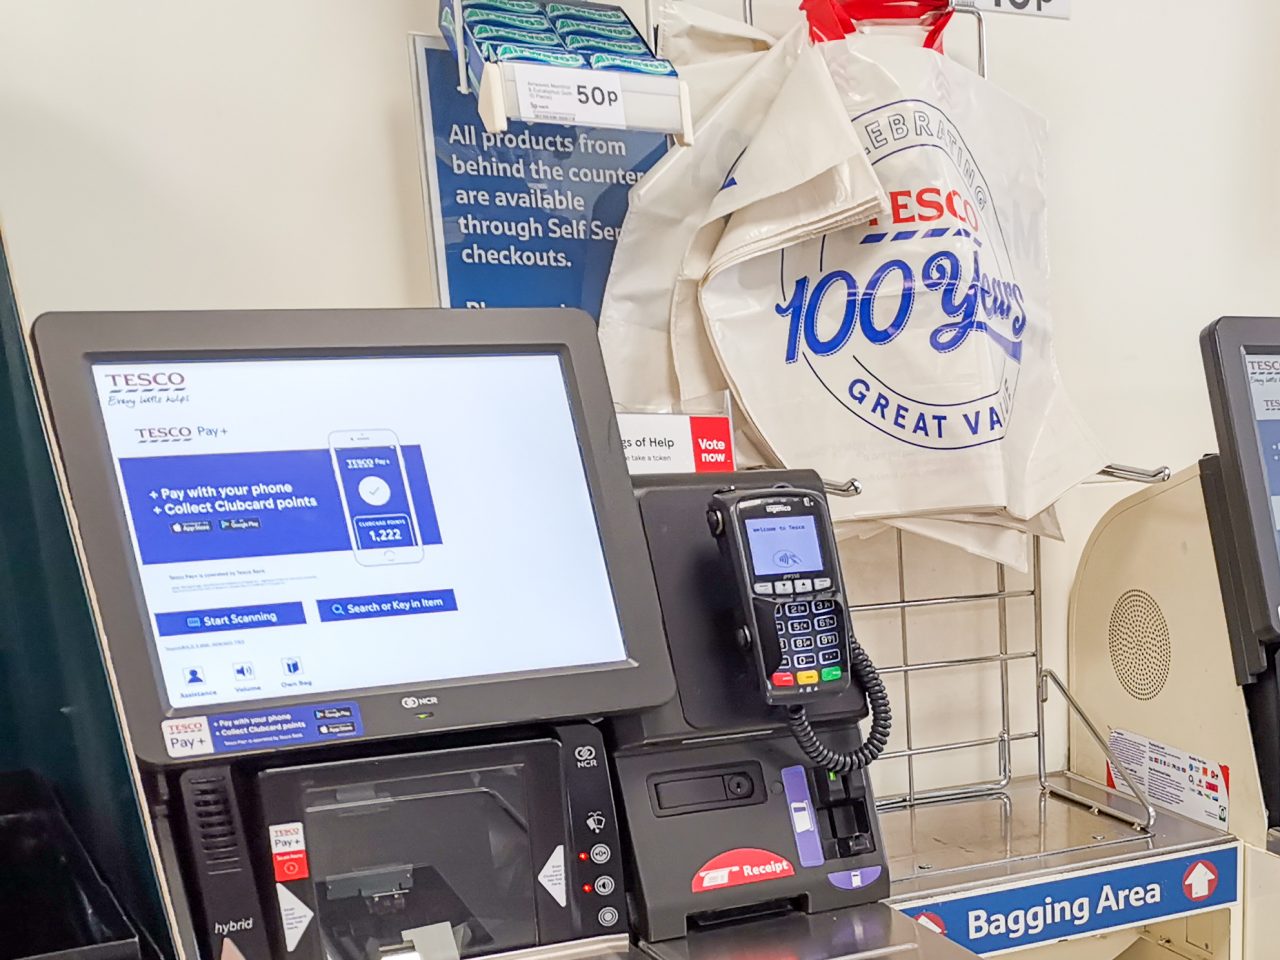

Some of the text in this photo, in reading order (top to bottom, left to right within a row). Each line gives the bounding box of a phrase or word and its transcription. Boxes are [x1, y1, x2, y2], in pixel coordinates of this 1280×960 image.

[576, 84, 618, 107] 50p
[449, 123, 626, 156] All products from
[452, 155, 643, 185] behind the counter
[864, 110, 988, 212] EBRATING
[456, 188, 585, 211] are available
[458, 215, 543, 241] through
[547, 218, 587, 240] Self
[461, 244, 572, 268] checkouts.
[775, 251, 1028, 364] 100 Years
[104, 372, 185, 387] TESCO
[848, 378, 948, 438] GREAT
[134, 426, 192, 438] TESCO
[635, 437, 646, 447] of
[649, 437, 675, 449] Help
[698, 438, 726, 450] Vote
[701, 452, 726, 462] now
[161, 483, 293, 501] Pay with your phone
[164, 496, 318, 515] Collect Clubcard points
[369, 529, 402, 542] 1,222
[347, 598, 443, 614] Search or Key in Item
[204, 611, 278, 627] Start Scanning
[418, 697, 438, 705] NCR
[168, 722, 203, 731] TESCO
[577, 760, 597, 768] NCR
[742, 860, 789, 876] Receipt
[968, 883, 1161, 939] Bagging Area
[215, 917, 253, 935] hybrid
